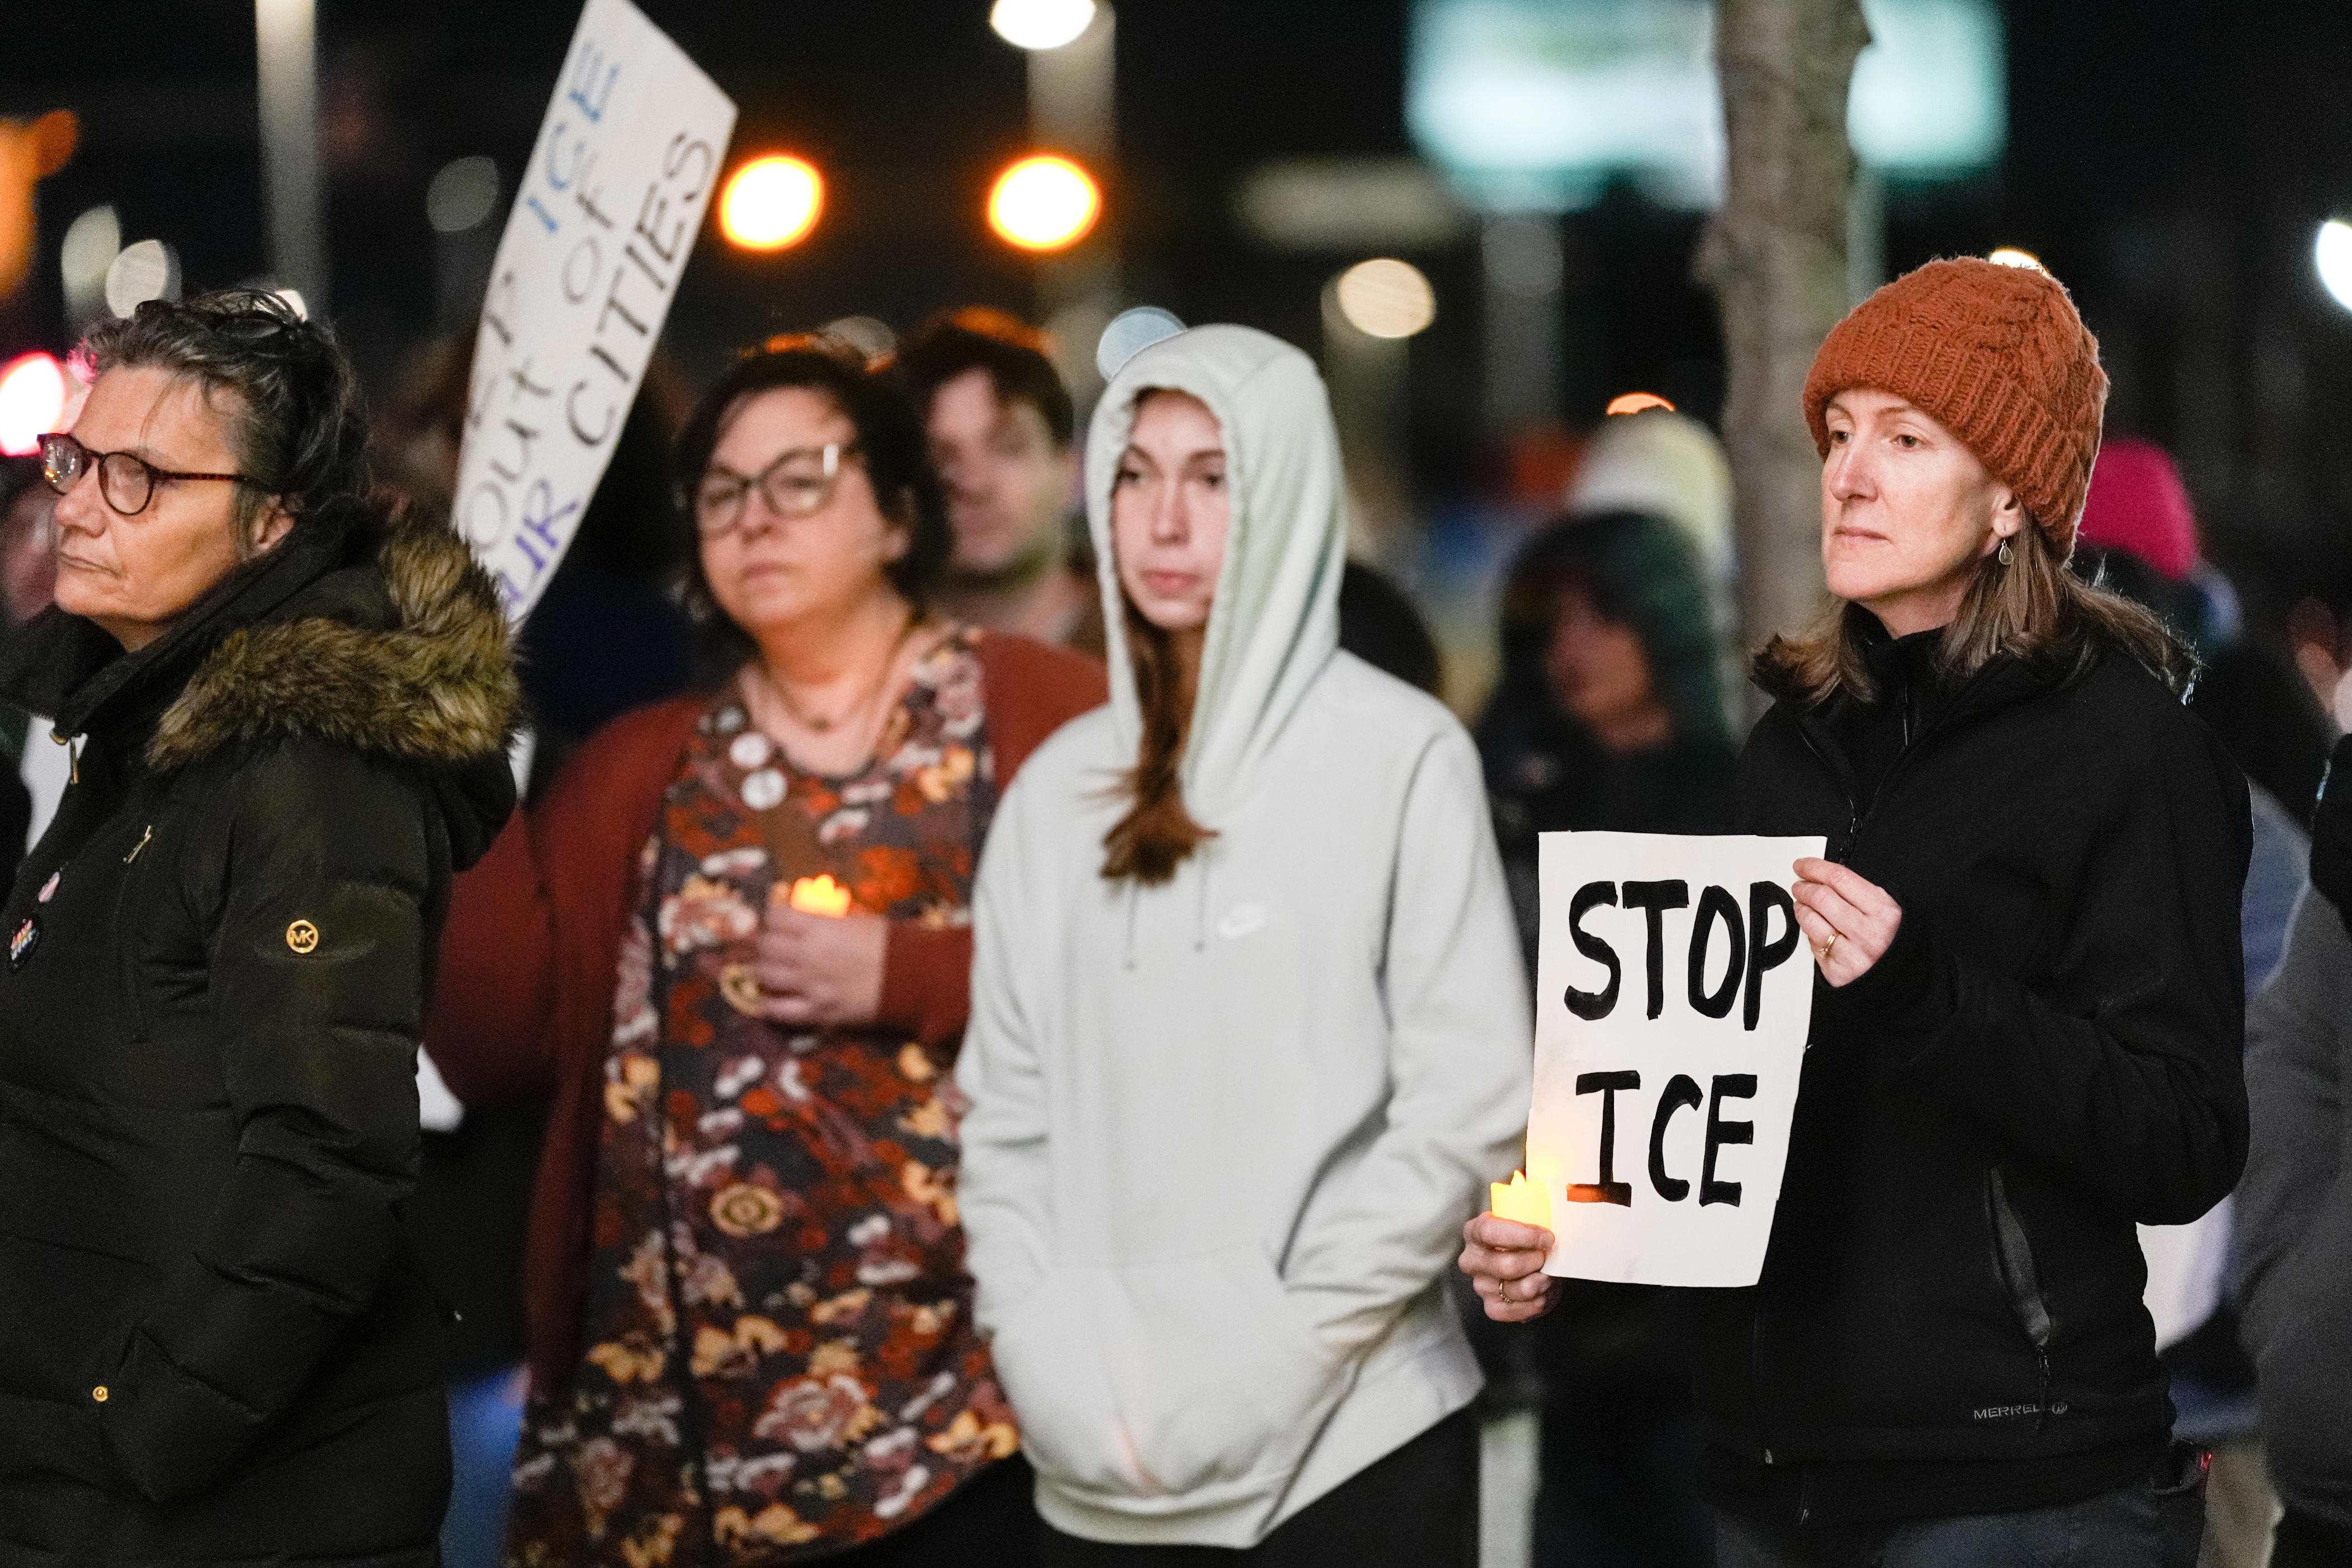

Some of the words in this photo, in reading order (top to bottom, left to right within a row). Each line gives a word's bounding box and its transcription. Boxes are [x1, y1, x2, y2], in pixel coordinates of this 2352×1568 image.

[527, 39, 621, 234] ICE
[495, 478, 579, 618] UR
[564, 130, 714, 448] CITIES
[1564, 879, 1800, 1031] STOP
[1566, 1070, 1758, 1208] ICE
[1973, 1404, 2051, 1420] MERREL
